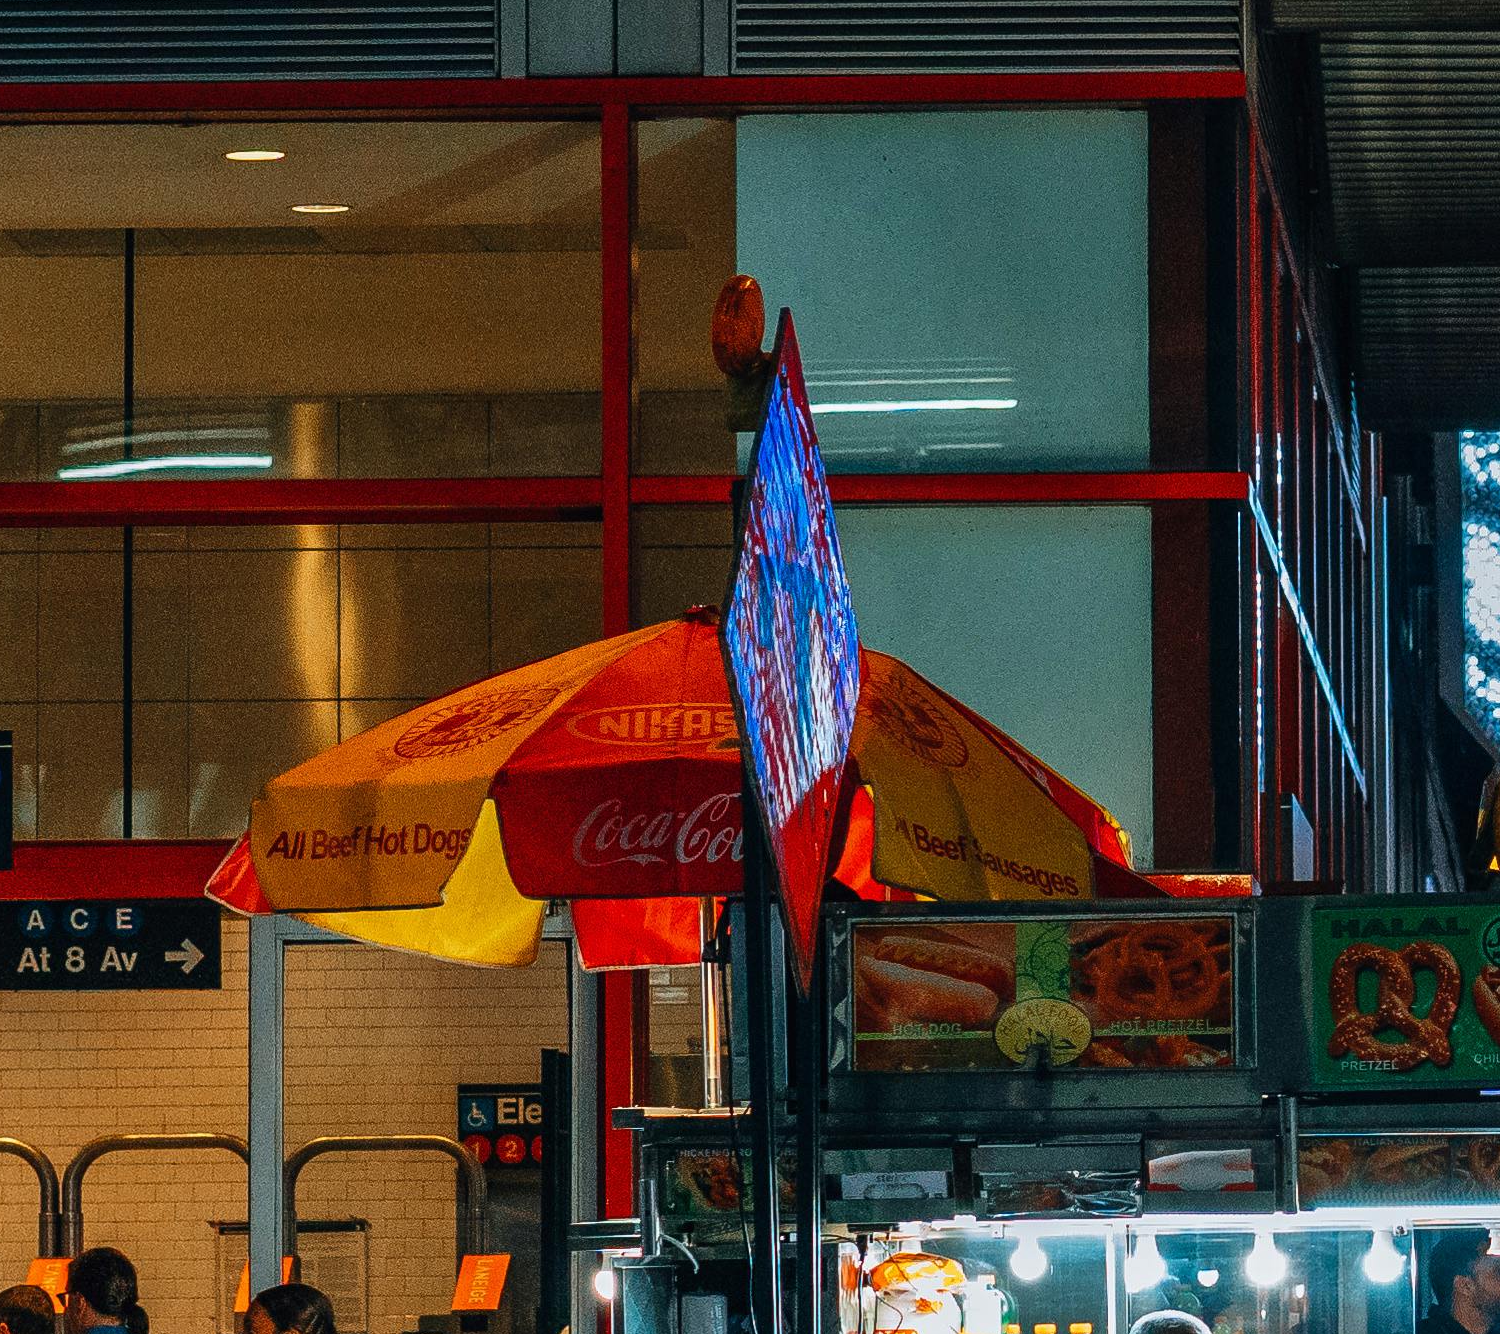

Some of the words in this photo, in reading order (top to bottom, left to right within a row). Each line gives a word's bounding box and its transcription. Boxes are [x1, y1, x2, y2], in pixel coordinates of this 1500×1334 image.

[266, 830, 306, 860] All
[310, 825, 363, 860] Beef
[364, 824, 409, 857] Hot
[915, 818, 970, 866] Beef
[27, 907, 46, 931] A
[69, 907, 90, 931] C
[116, 907, 134, 930] E
[1330, 916, 1470, 939] HALAL
[16, 946, 51, 973] At
[65, 946, 86, 973] 8
[100, 946, 139, 973] Av
[929, 1023, 963, 1036] DOG
[1340, 1059, 1400, 1072] PRETZEL
